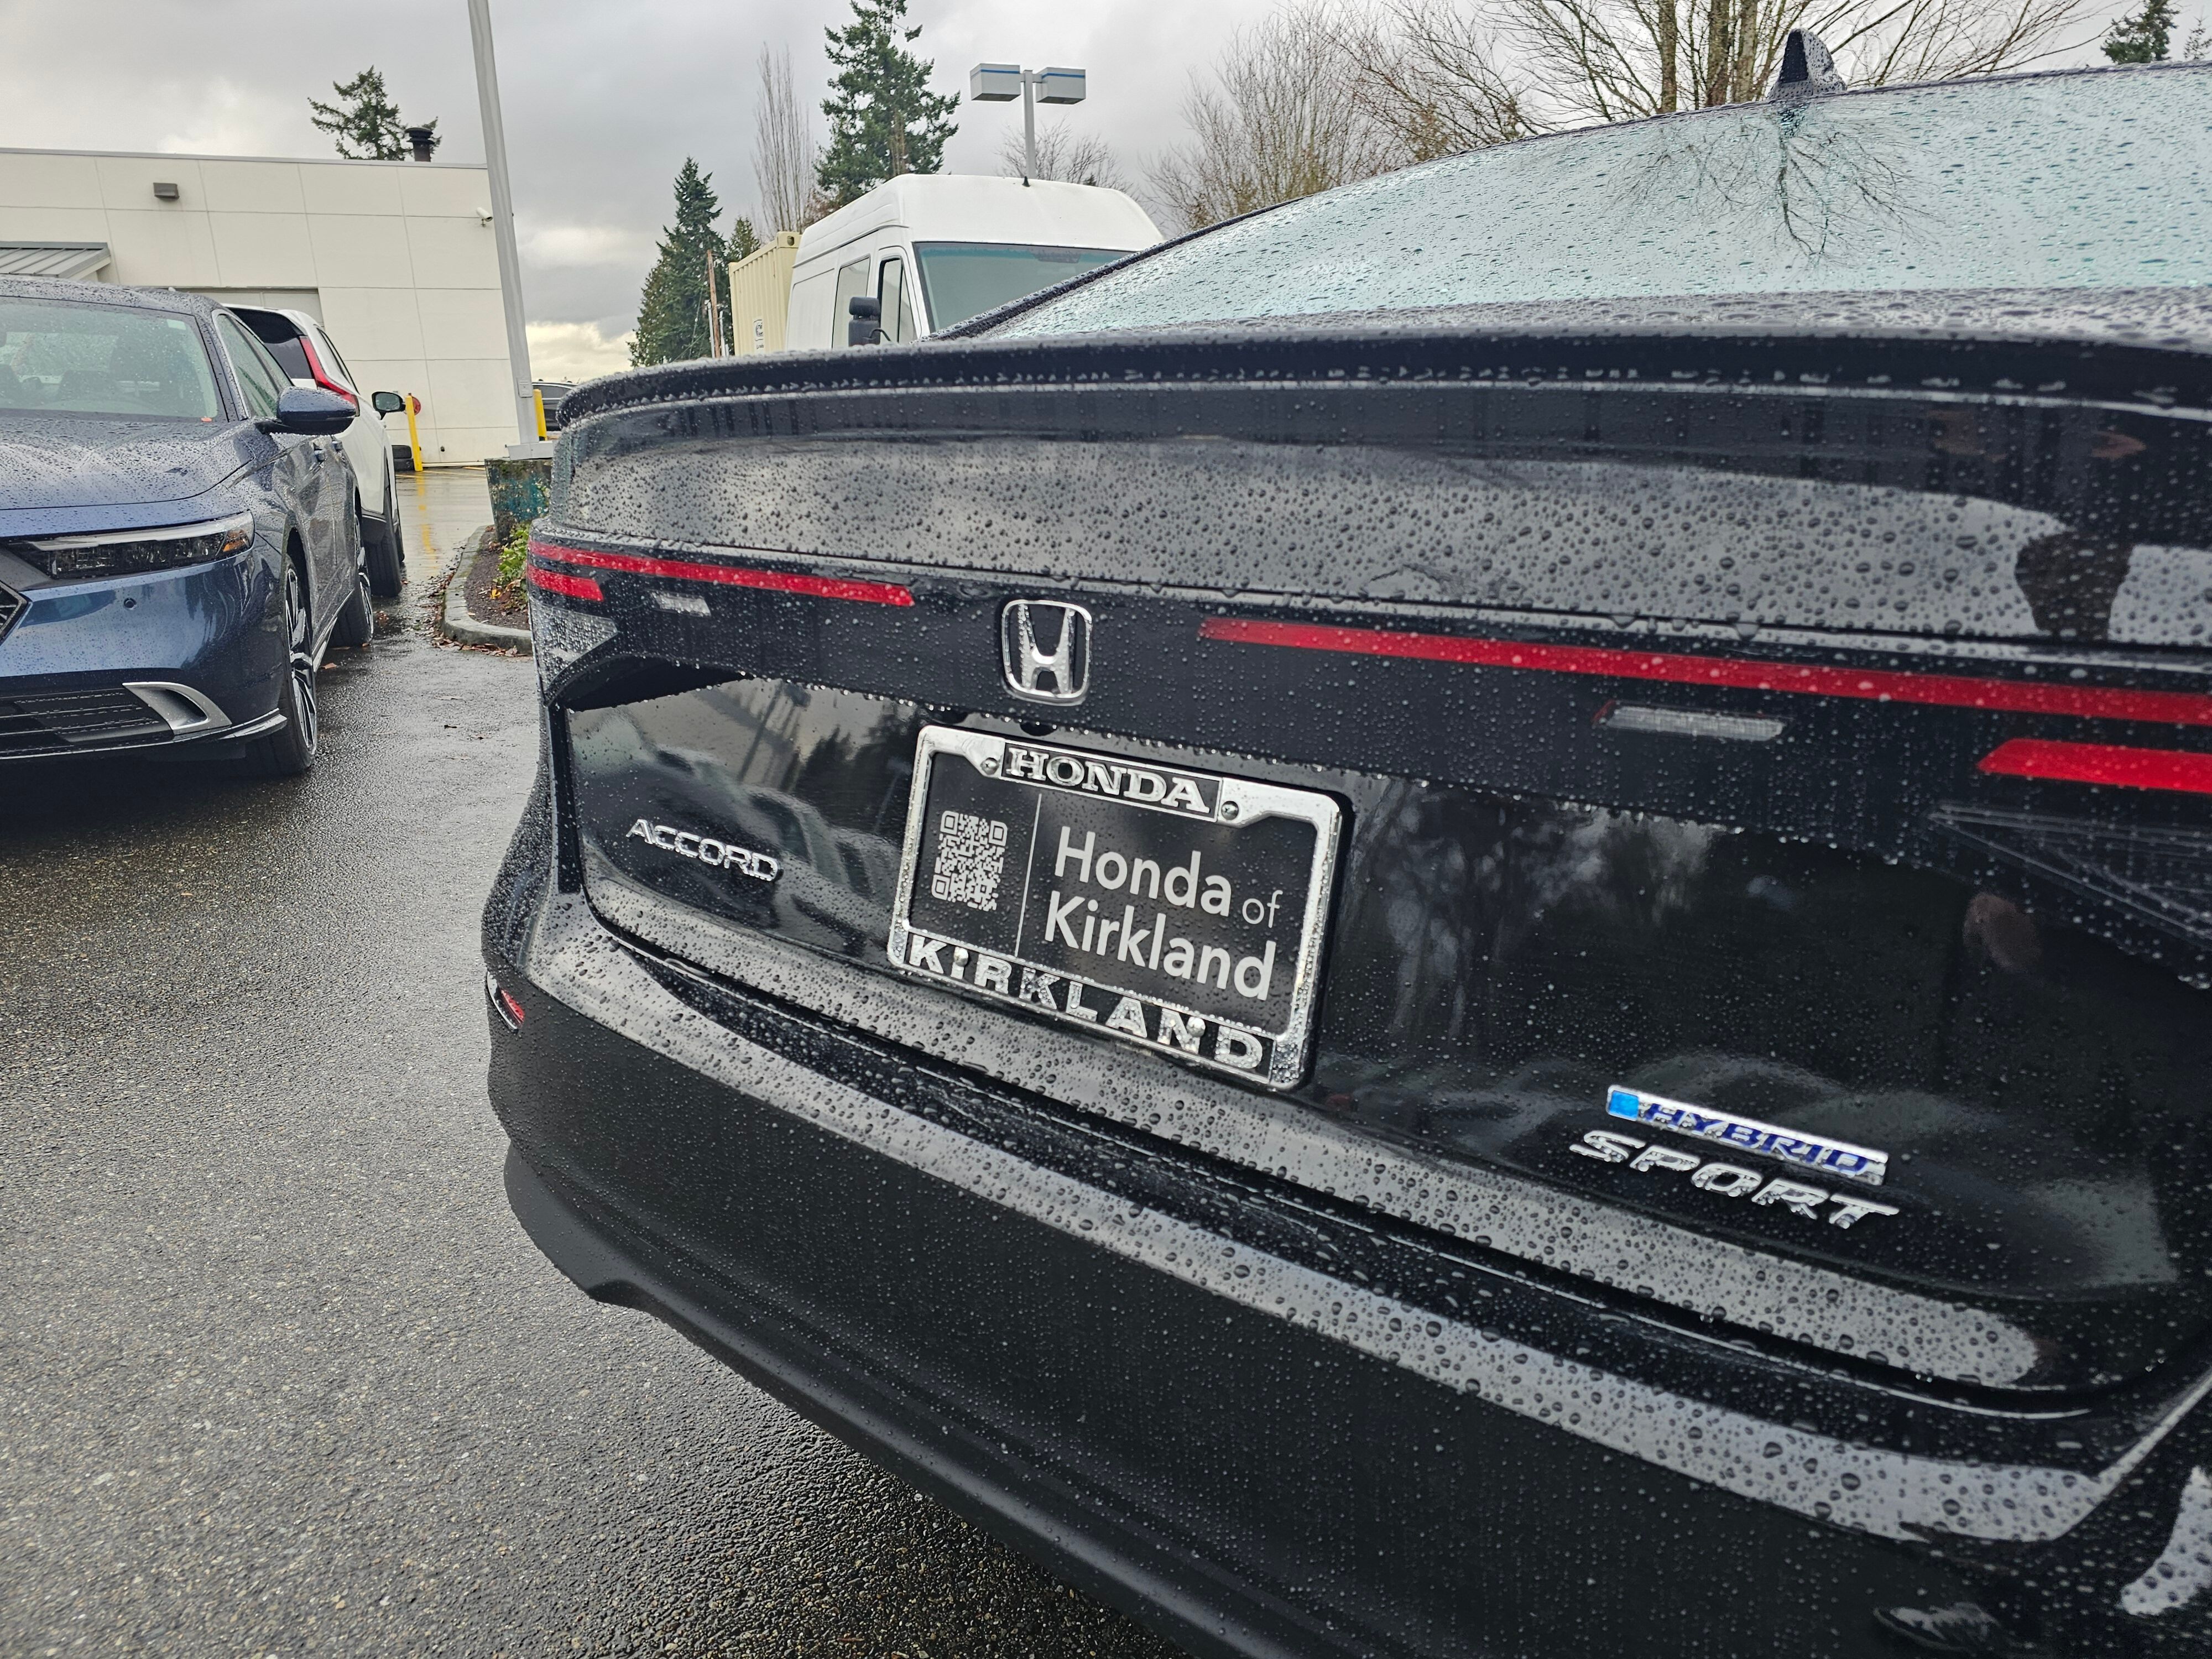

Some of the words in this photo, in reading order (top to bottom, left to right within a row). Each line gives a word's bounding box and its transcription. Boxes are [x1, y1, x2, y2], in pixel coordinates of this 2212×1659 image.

[1007, 747, 1210, 815] HONDA
[625, 819, 779, 881] ACCORD
[1055, 825, 1232, 917] Honda
[1241, 890, 1281, 928] of
[1045, 890, 1276, 1001] Kirkland
[909, 935, 1264, 1070] KIRKLAND
[1569, 1130, 1900, 1229] SPORT
[1645, 1102, 1868, 1176] HYBRID
